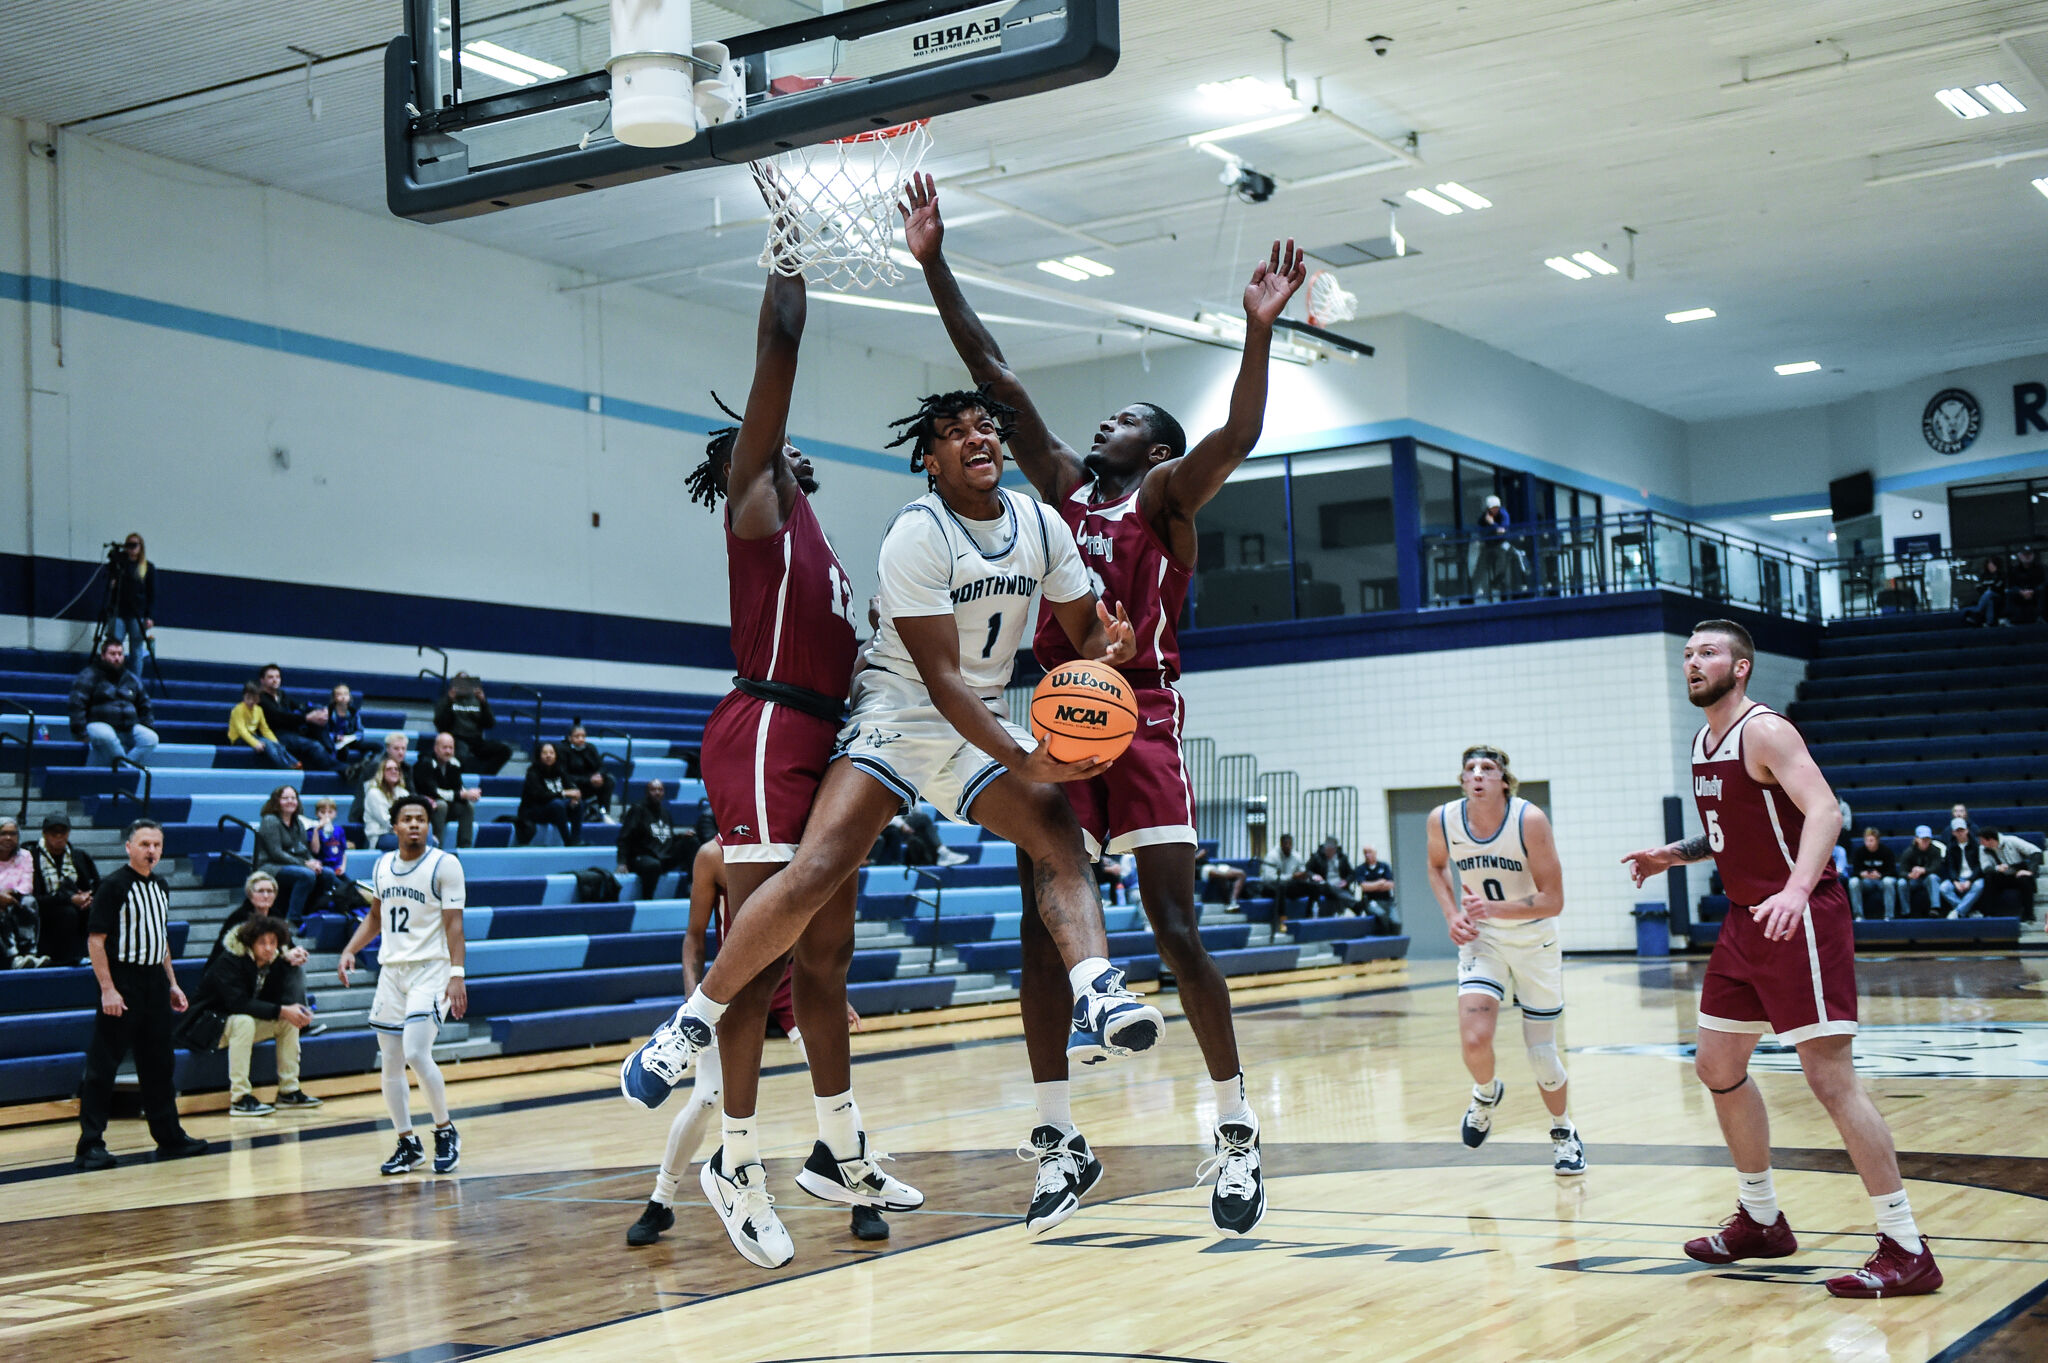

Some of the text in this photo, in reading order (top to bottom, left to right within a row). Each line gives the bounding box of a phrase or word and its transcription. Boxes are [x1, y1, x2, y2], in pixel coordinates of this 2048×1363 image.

[2012, 381, 2048, 436] R
[982, 611, 1002, 659] 1
[1052, 672, 1121, 700] Wilson
[1055, 705, 1107, 726] NCAA
[1705, 809, 1725, 853] 5
[381, 886, 426, 904] RTHWOOD
[390, 906, 409, 933] 12
